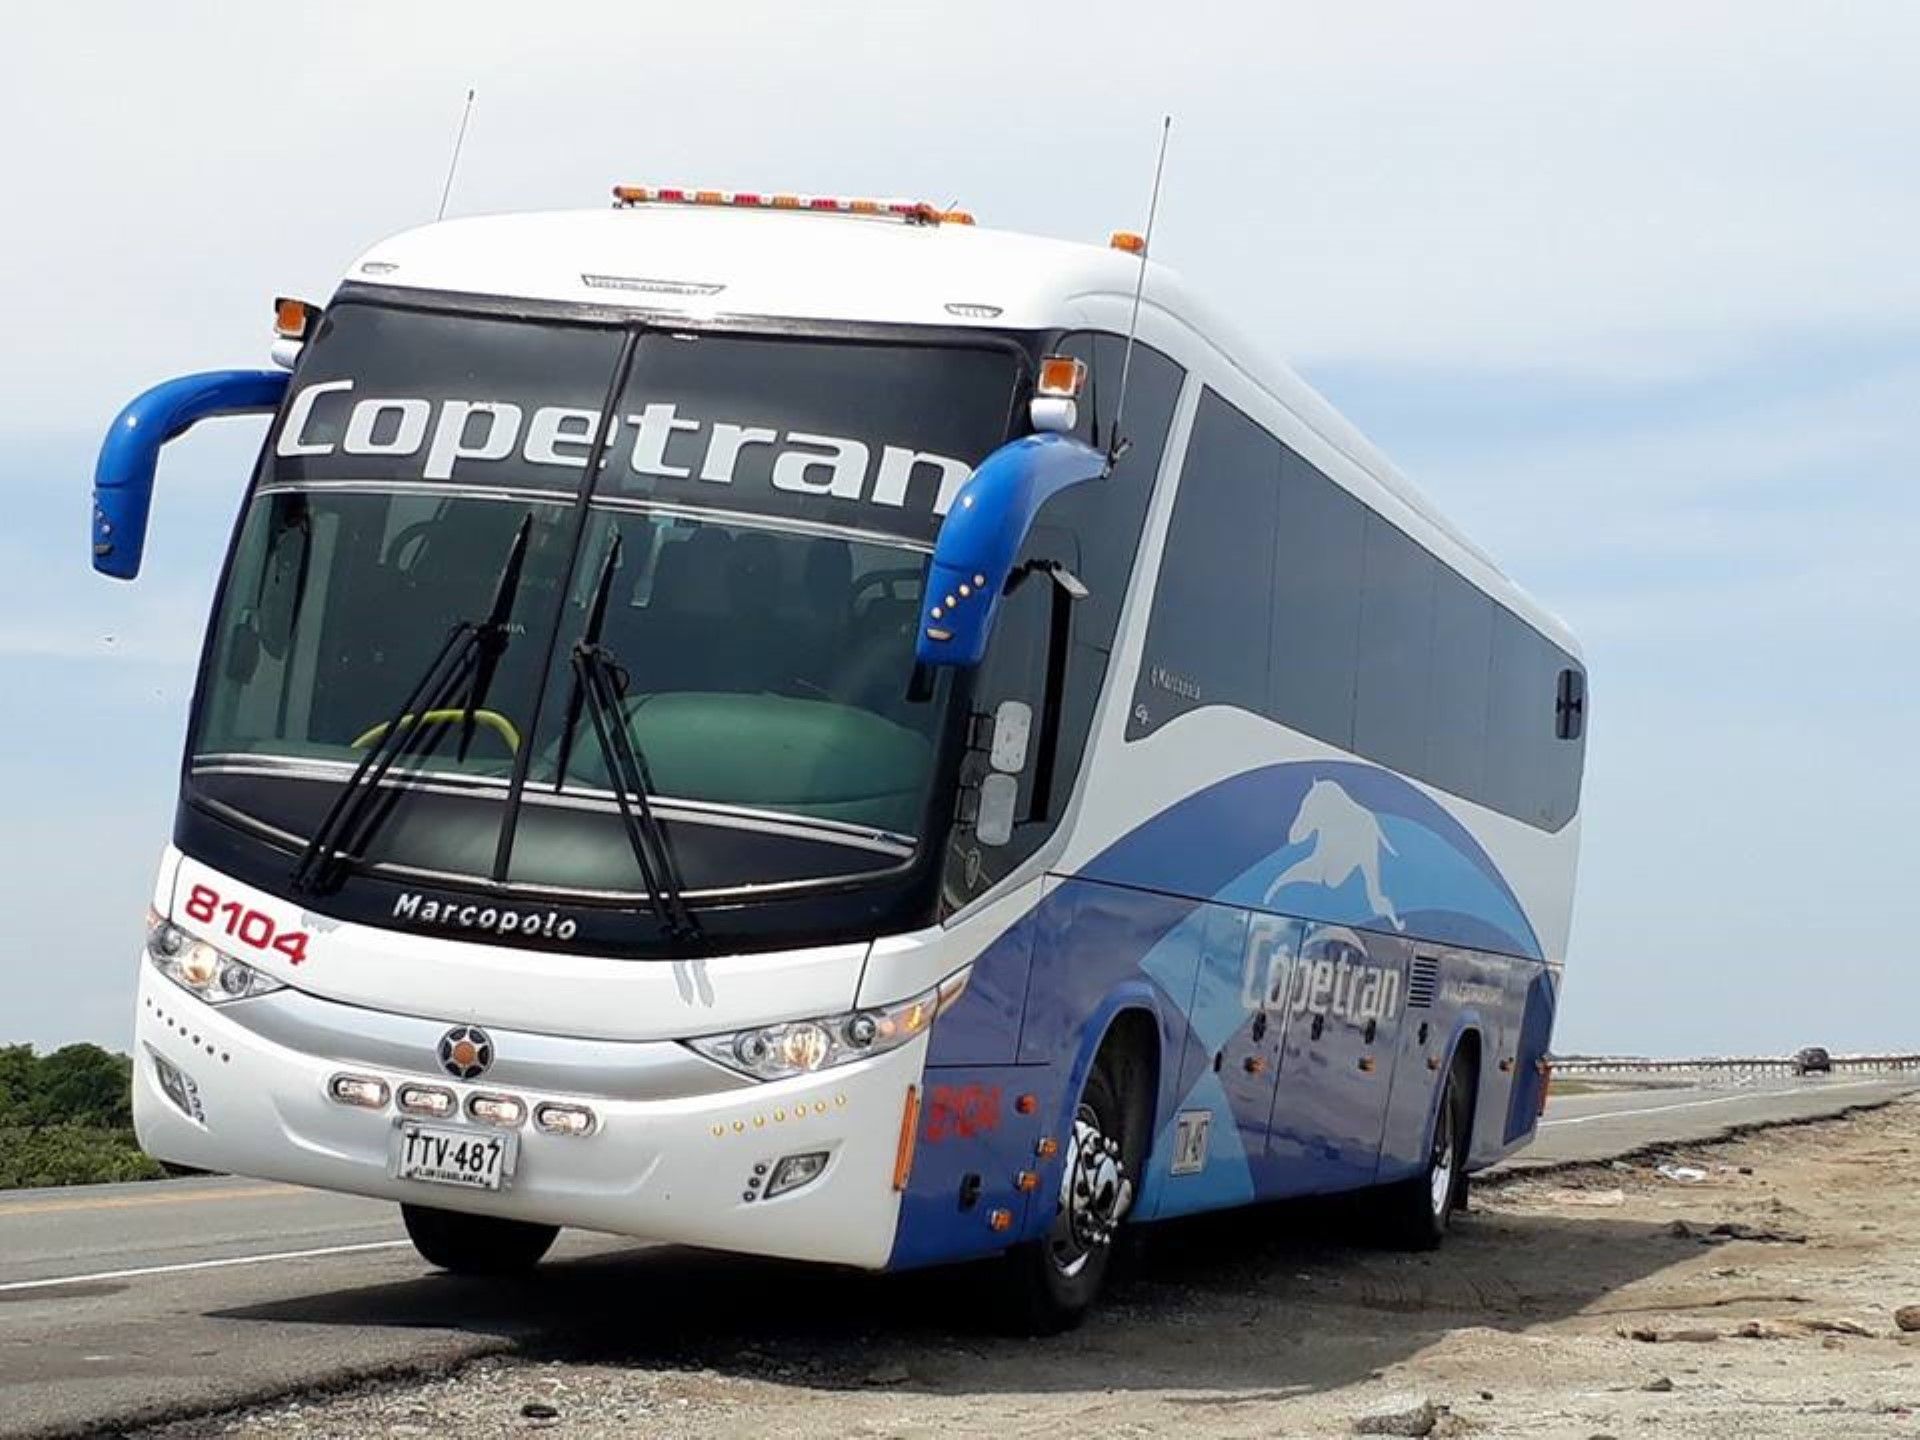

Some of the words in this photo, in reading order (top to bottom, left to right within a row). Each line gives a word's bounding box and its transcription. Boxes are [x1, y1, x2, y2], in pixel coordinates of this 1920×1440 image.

[276, 379, 974, 515] Copetran
[185, 884, 309, 966] 8104
[393, 893, 577, 940] Marcopolo
[1242, 929, 1400, 1024] Copetran
